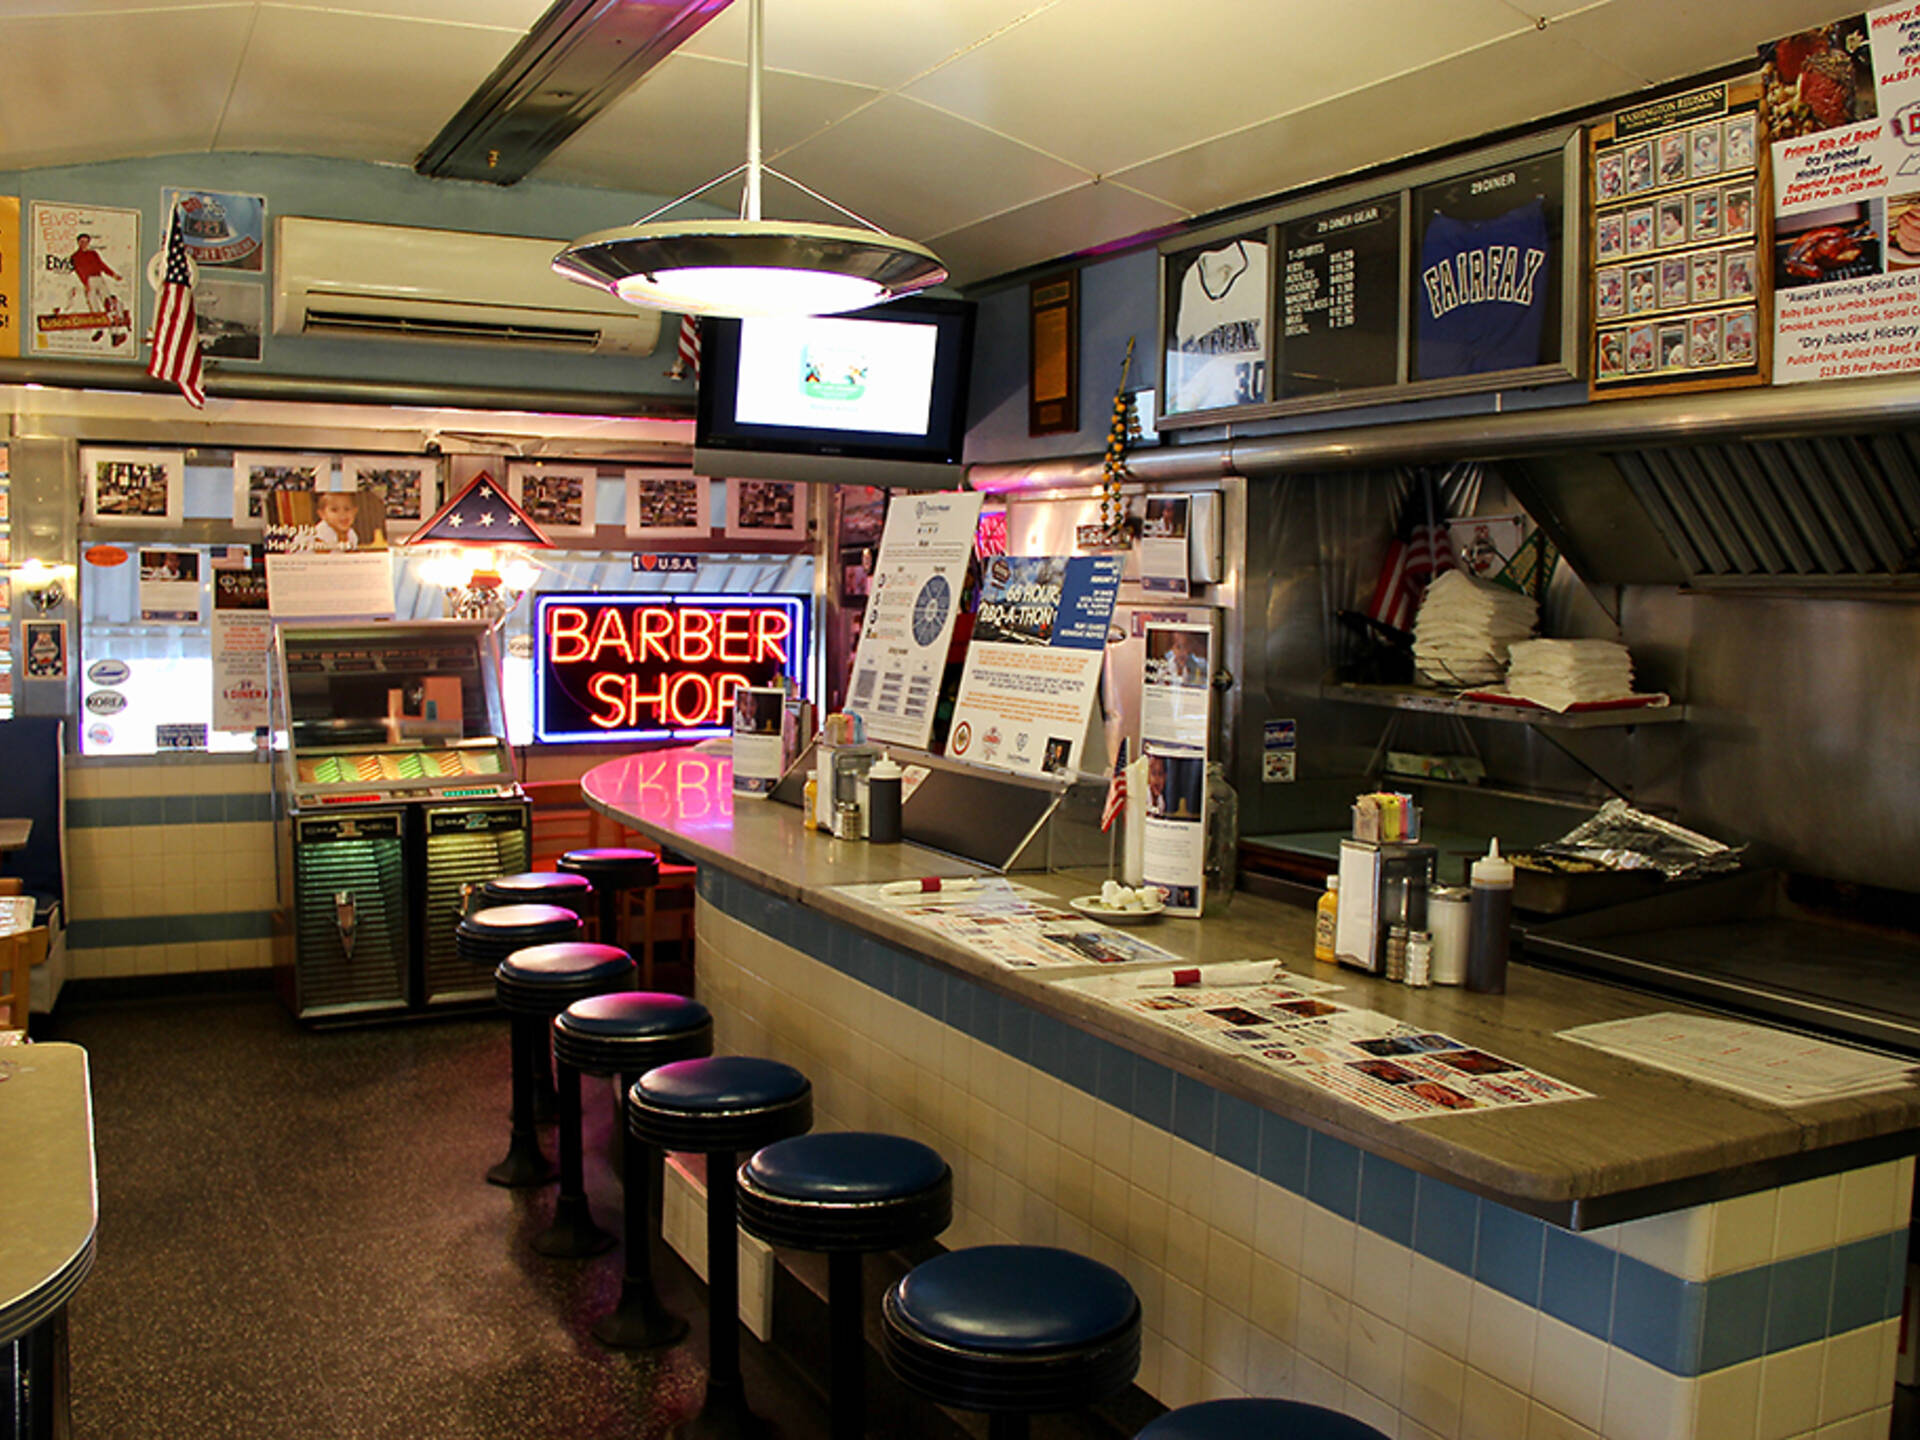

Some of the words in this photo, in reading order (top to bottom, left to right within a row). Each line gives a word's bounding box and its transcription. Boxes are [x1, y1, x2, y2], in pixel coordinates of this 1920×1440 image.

[1423, 245, 1545, 319] FAIRFAX
[266, 524, 297, 537] Help
[268, 539, 296, 553] Help
[549, 605, 790, 664] BARBER
[589, 671, 749, 728] SHOP
